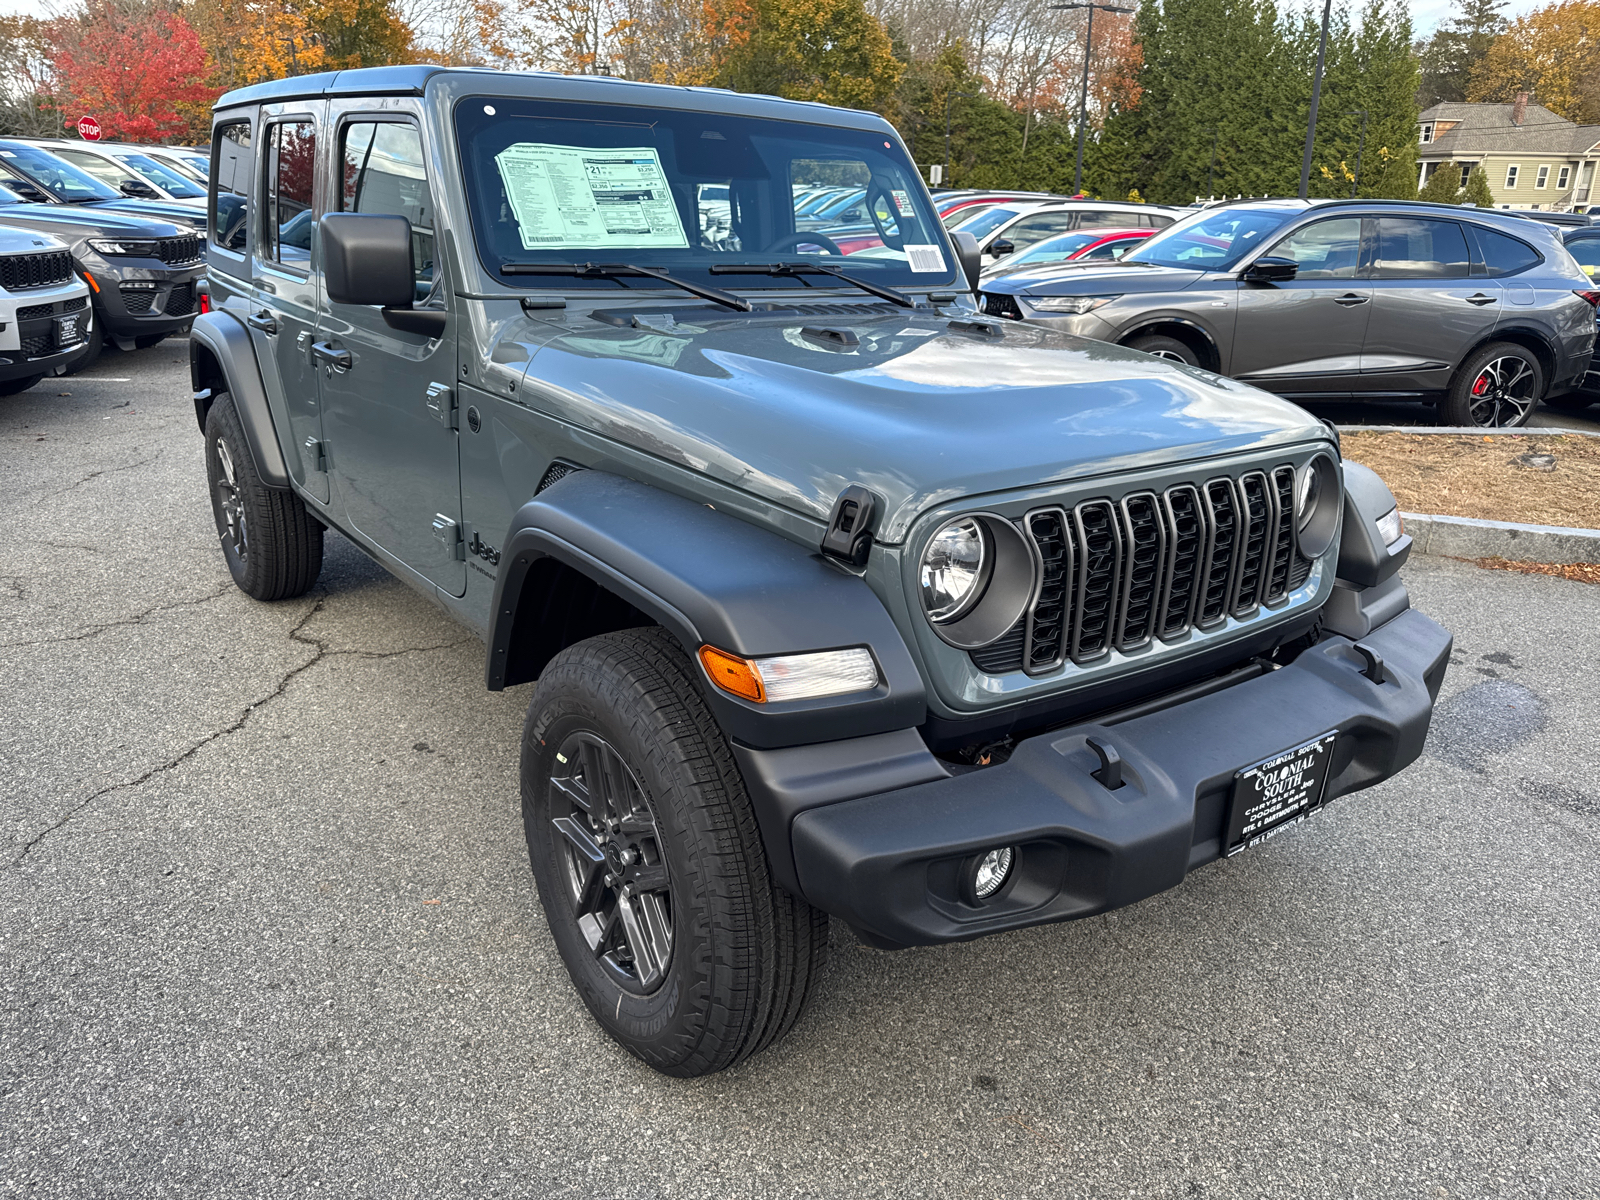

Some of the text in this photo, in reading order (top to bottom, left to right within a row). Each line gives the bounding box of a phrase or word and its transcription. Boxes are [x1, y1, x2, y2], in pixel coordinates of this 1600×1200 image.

[80, 123, 99, 136] STOP
[590, 166, 600, 174] 21
[1255, 754, 1315, 791] COLONIAL
[1263, 771, 1303, 801] SOUTH
[1244, 779, 1315, 816] CHRYSLER Jeep
[1250, 791, 1306, 822] DODGE RAM
[1257, 820, 1262, 828] 6
